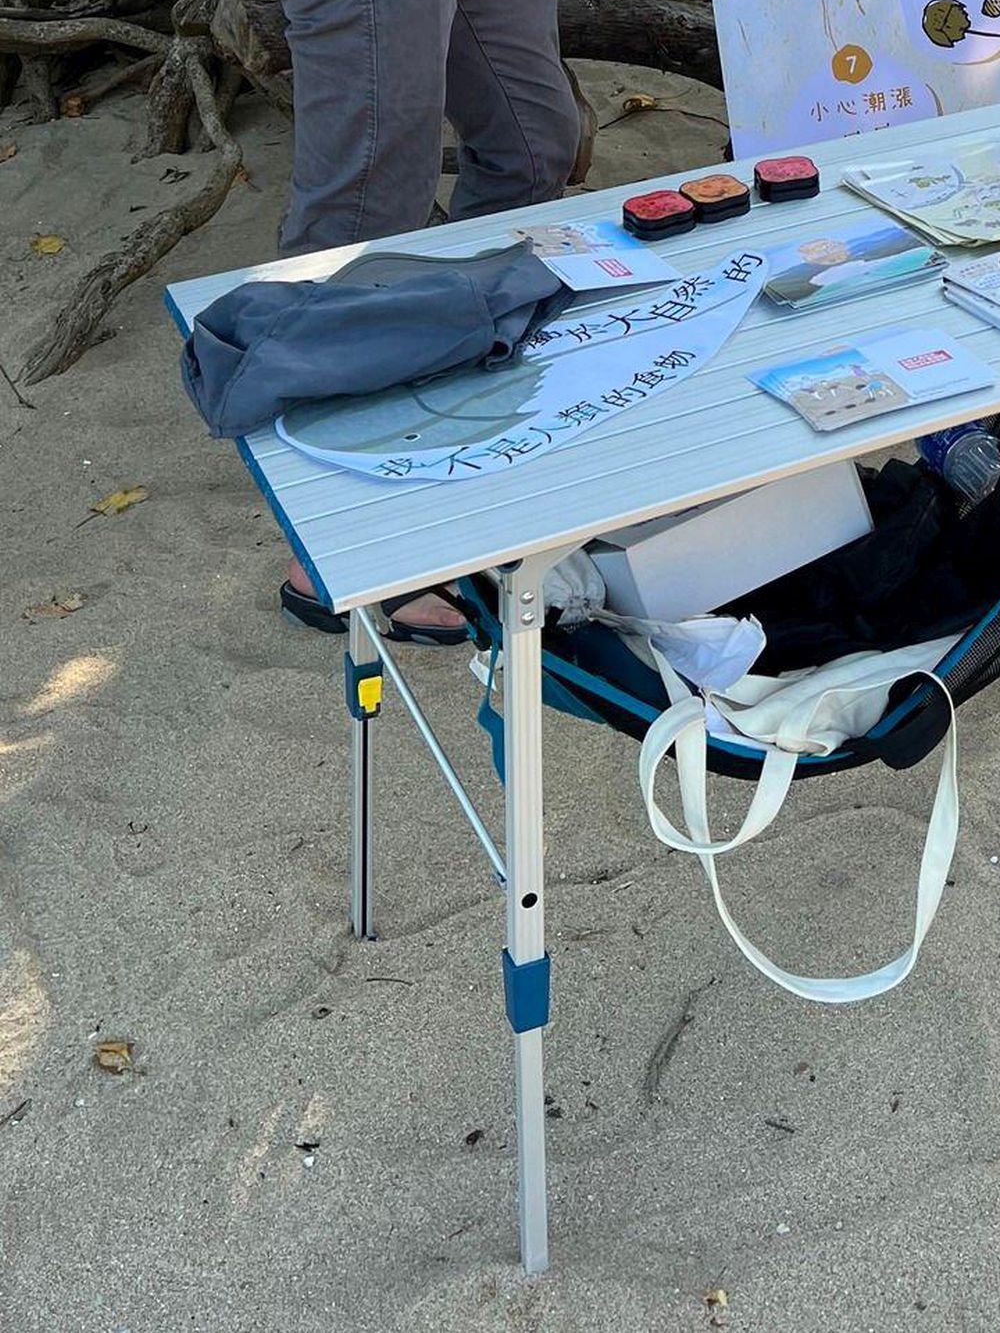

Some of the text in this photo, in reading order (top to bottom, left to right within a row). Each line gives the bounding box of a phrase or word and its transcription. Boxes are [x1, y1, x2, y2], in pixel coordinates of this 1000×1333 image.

[845, 55, 857, 74] 7
[810, 86, 913, 122] 小心潮漲
[375, 350, 697, 477] 我不是人類的食物
